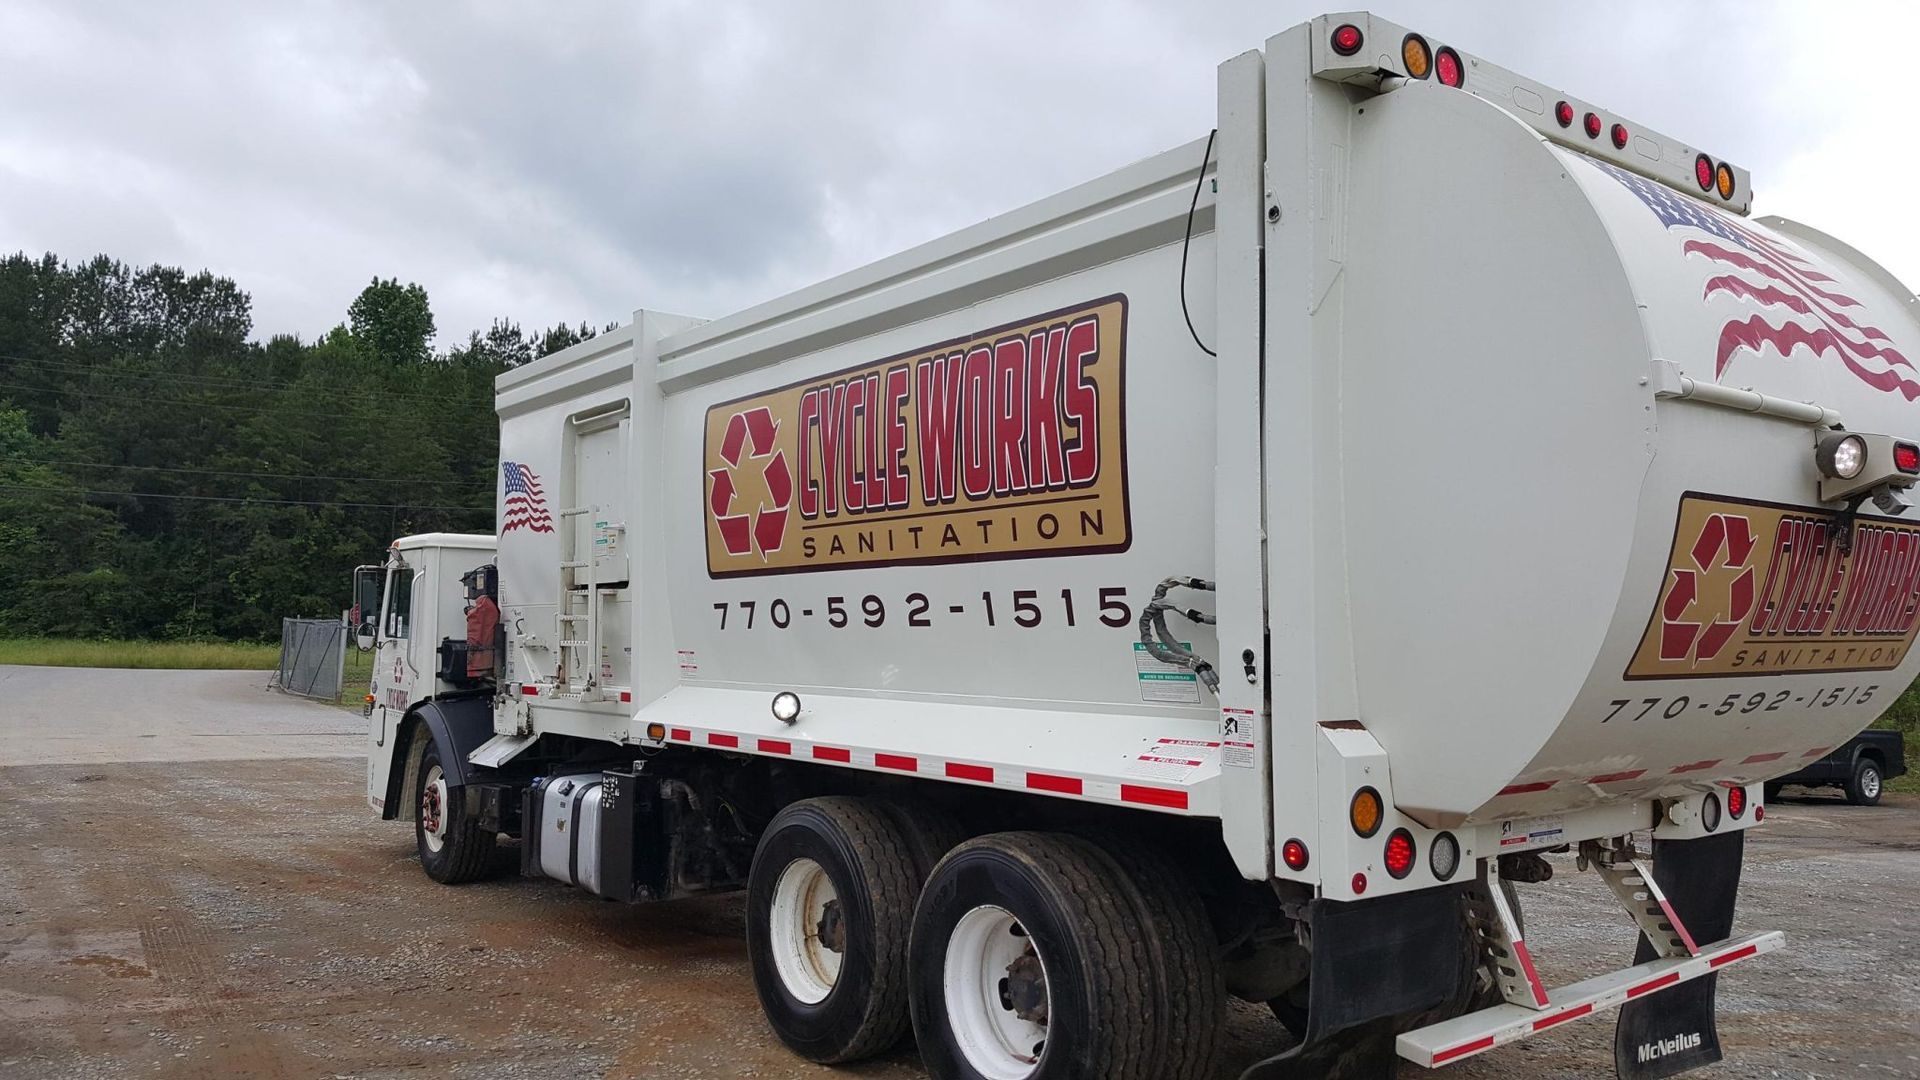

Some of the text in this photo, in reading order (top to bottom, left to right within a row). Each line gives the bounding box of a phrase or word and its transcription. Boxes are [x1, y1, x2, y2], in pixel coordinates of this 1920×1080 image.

[797, 313, 1100, 520] CYCLE WORKS
[802, 509, 1104, 558] SANITATION
[1749, 514, 1847, 636] CYCLE
[714, 587, 1131, 630] 770-592-1515
[1732, 648, 1901, 667] SANITATION
[1601, 685, 1879, 723] 770-592-1515
[1638, 1032, 1701, 1063] McNeilus
